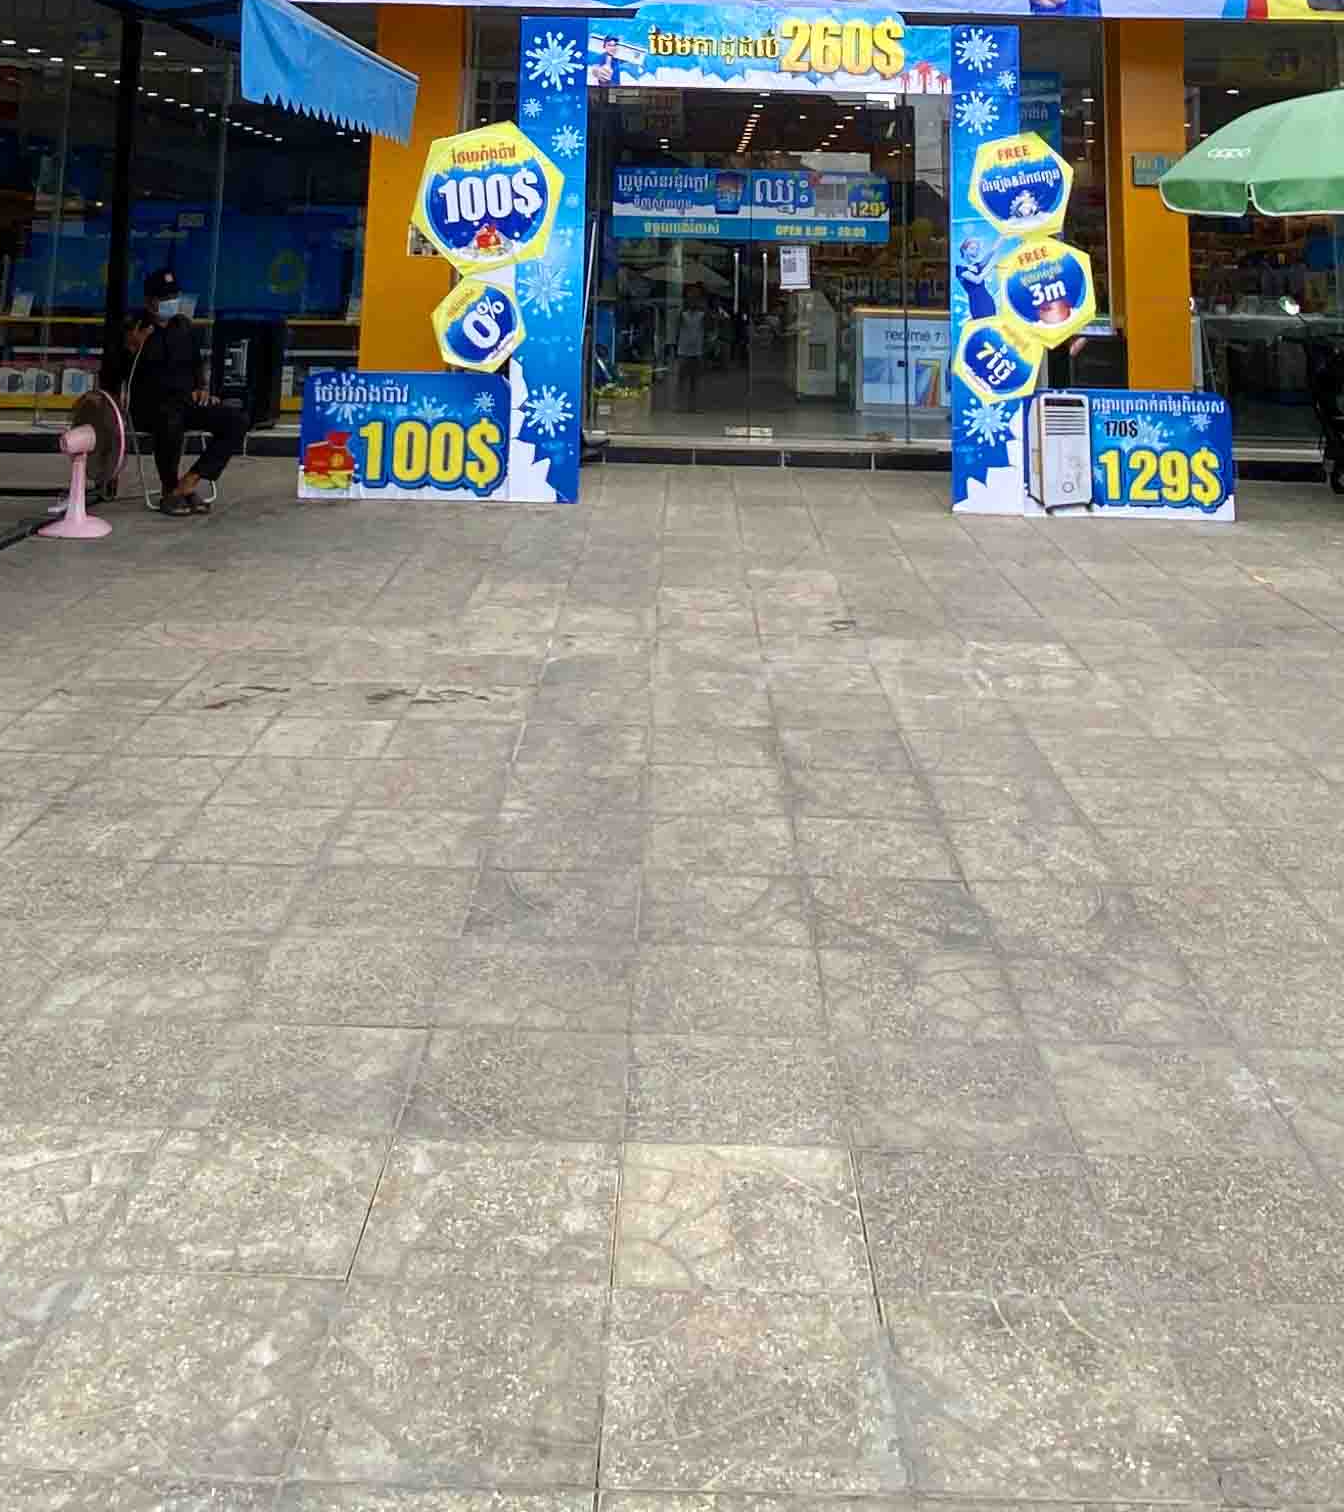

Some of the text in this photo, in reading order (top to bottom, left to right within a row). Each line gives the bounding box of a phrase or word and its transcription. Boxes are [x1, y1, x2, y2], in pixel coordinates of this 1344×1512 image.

[779, 18, 905, 80] 260$
[996, 144, 1030, 161] FREE
[439, 167, 544, 225] 100$
[1017, 246, 1049, 268] FREE
[1029, 280, 1066, 306] 3m
[462, 295, 505, 349] 0%
[359, 418, 502, 489] 100$
[1103, 419, 1139, 438] 170$
[1098, 448, 1222, 506] 129$
